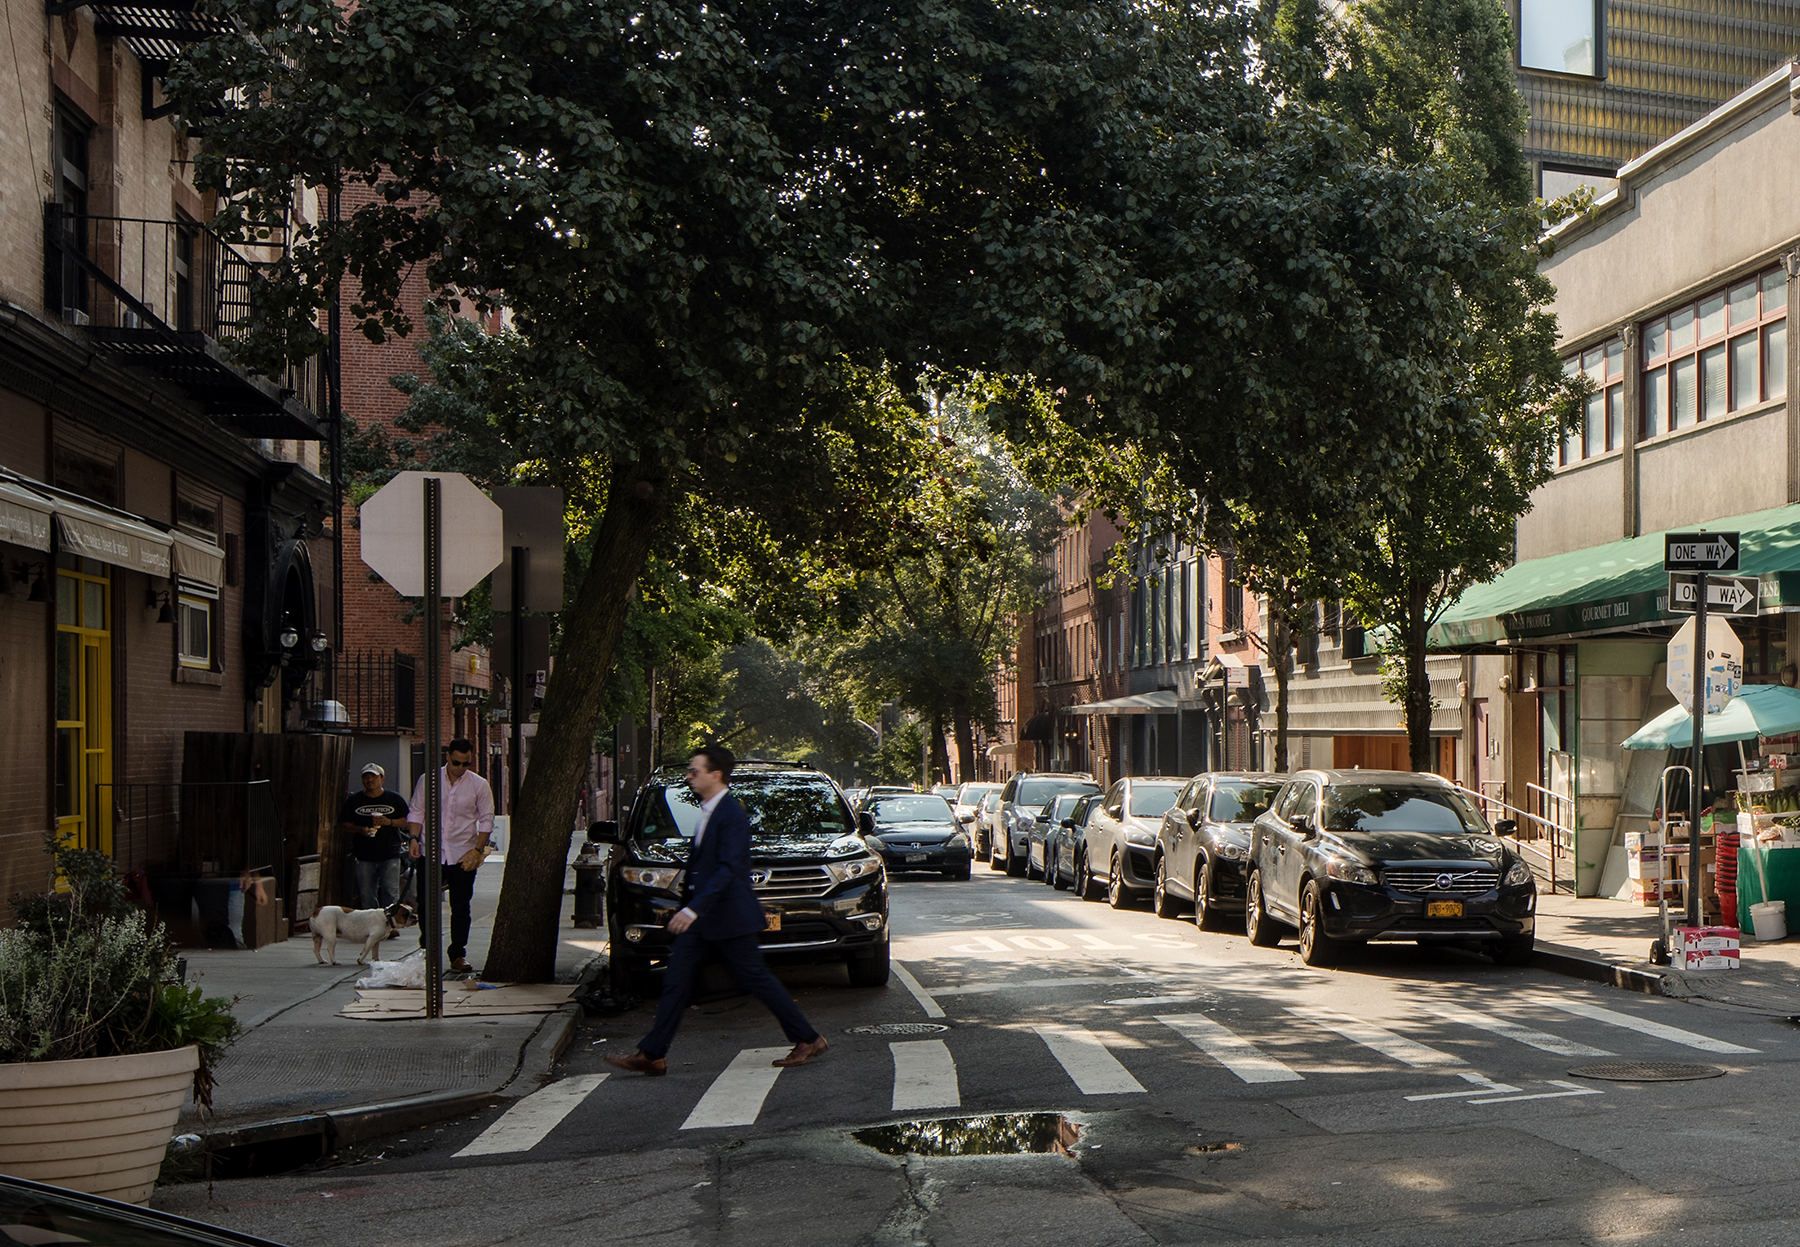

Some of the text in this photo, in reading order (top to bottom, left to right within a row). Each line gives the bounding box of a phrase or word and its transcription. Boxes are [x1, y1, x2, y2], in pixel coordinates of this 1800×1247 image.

[1675, 545, 1728, 560] ONE WAY
[1683, 586, 1746, 603] ON WAY
[1759, 580, 1780, 597] EESE
[1582, 601, 1629, 622] GOURMET DELI
[454, 697, 479, 706] drybar
[950, 932, 1199, 954] STOP
